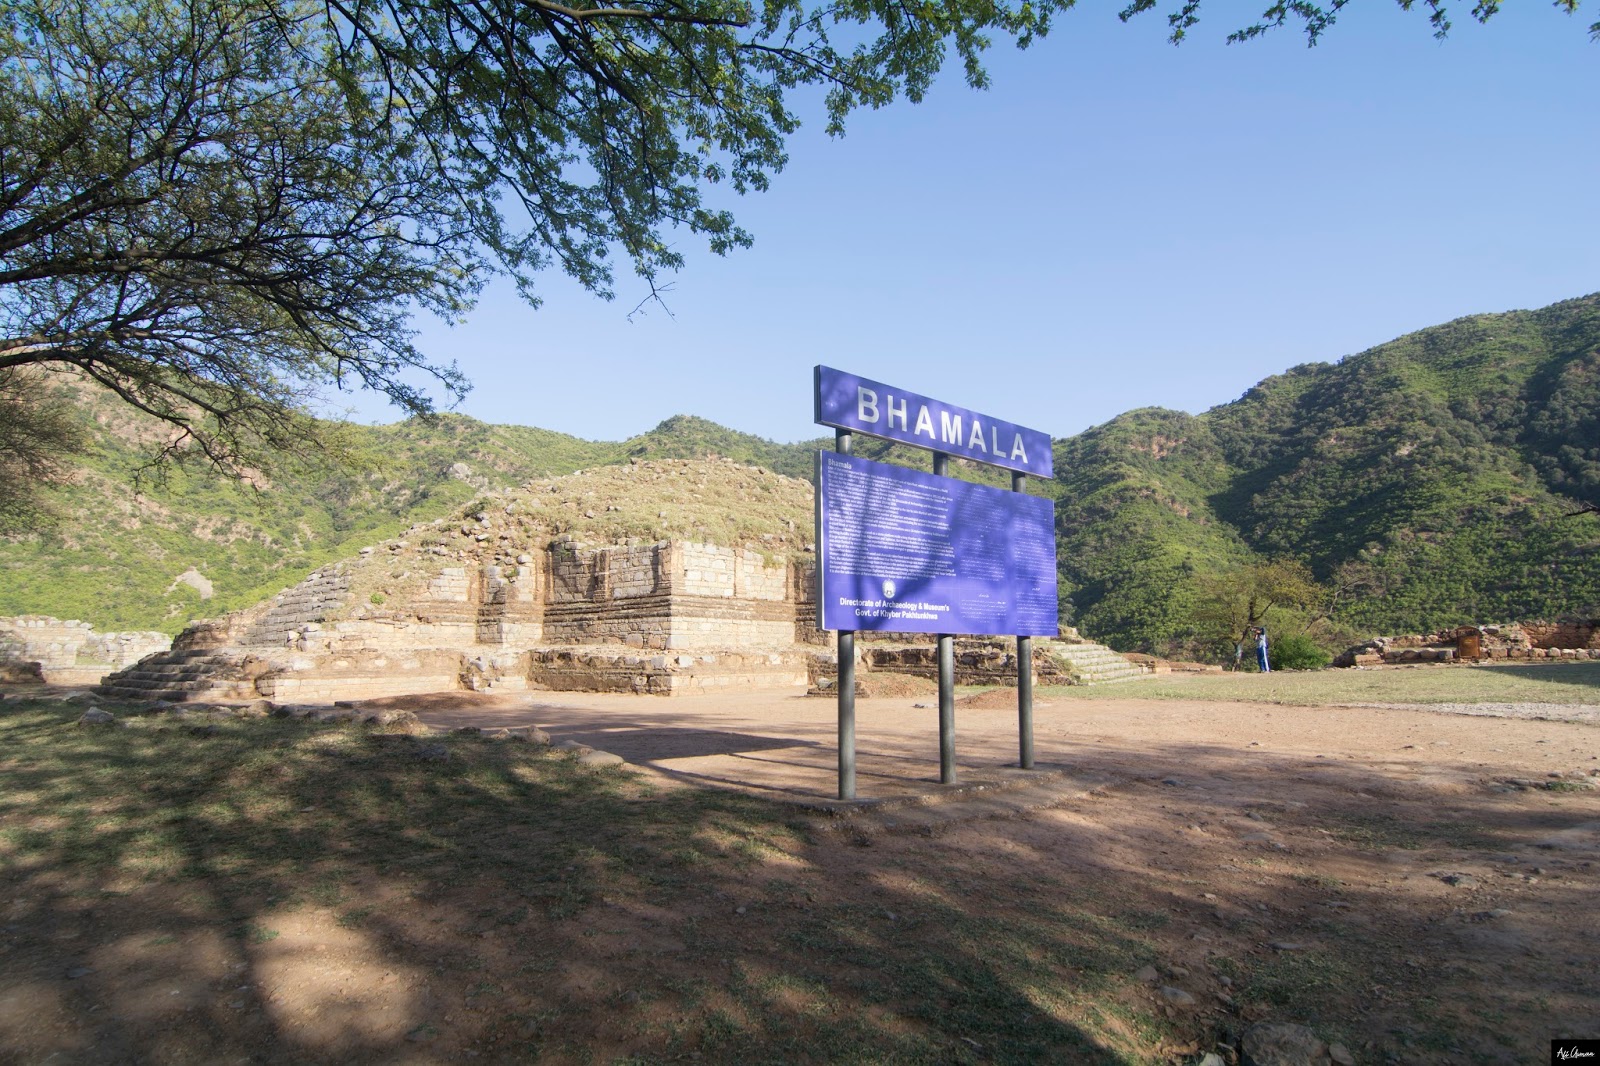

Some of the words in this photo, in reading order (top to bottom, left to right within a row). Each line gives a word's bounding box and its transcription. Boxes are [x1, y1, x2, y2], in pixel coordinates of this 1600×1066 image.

[857, 386, 1028, 463] BHAMALA
[828, 458, 852, 469] Bhamala
[840, 598, 874, 607] Directorate
[882, 601, 917, 610] Archaeology
[923, 603, 949, 611] Museum's
[880, 610, 901, 618] Khyber
[902, 611, 938, 619] Pakhtunkhwa
